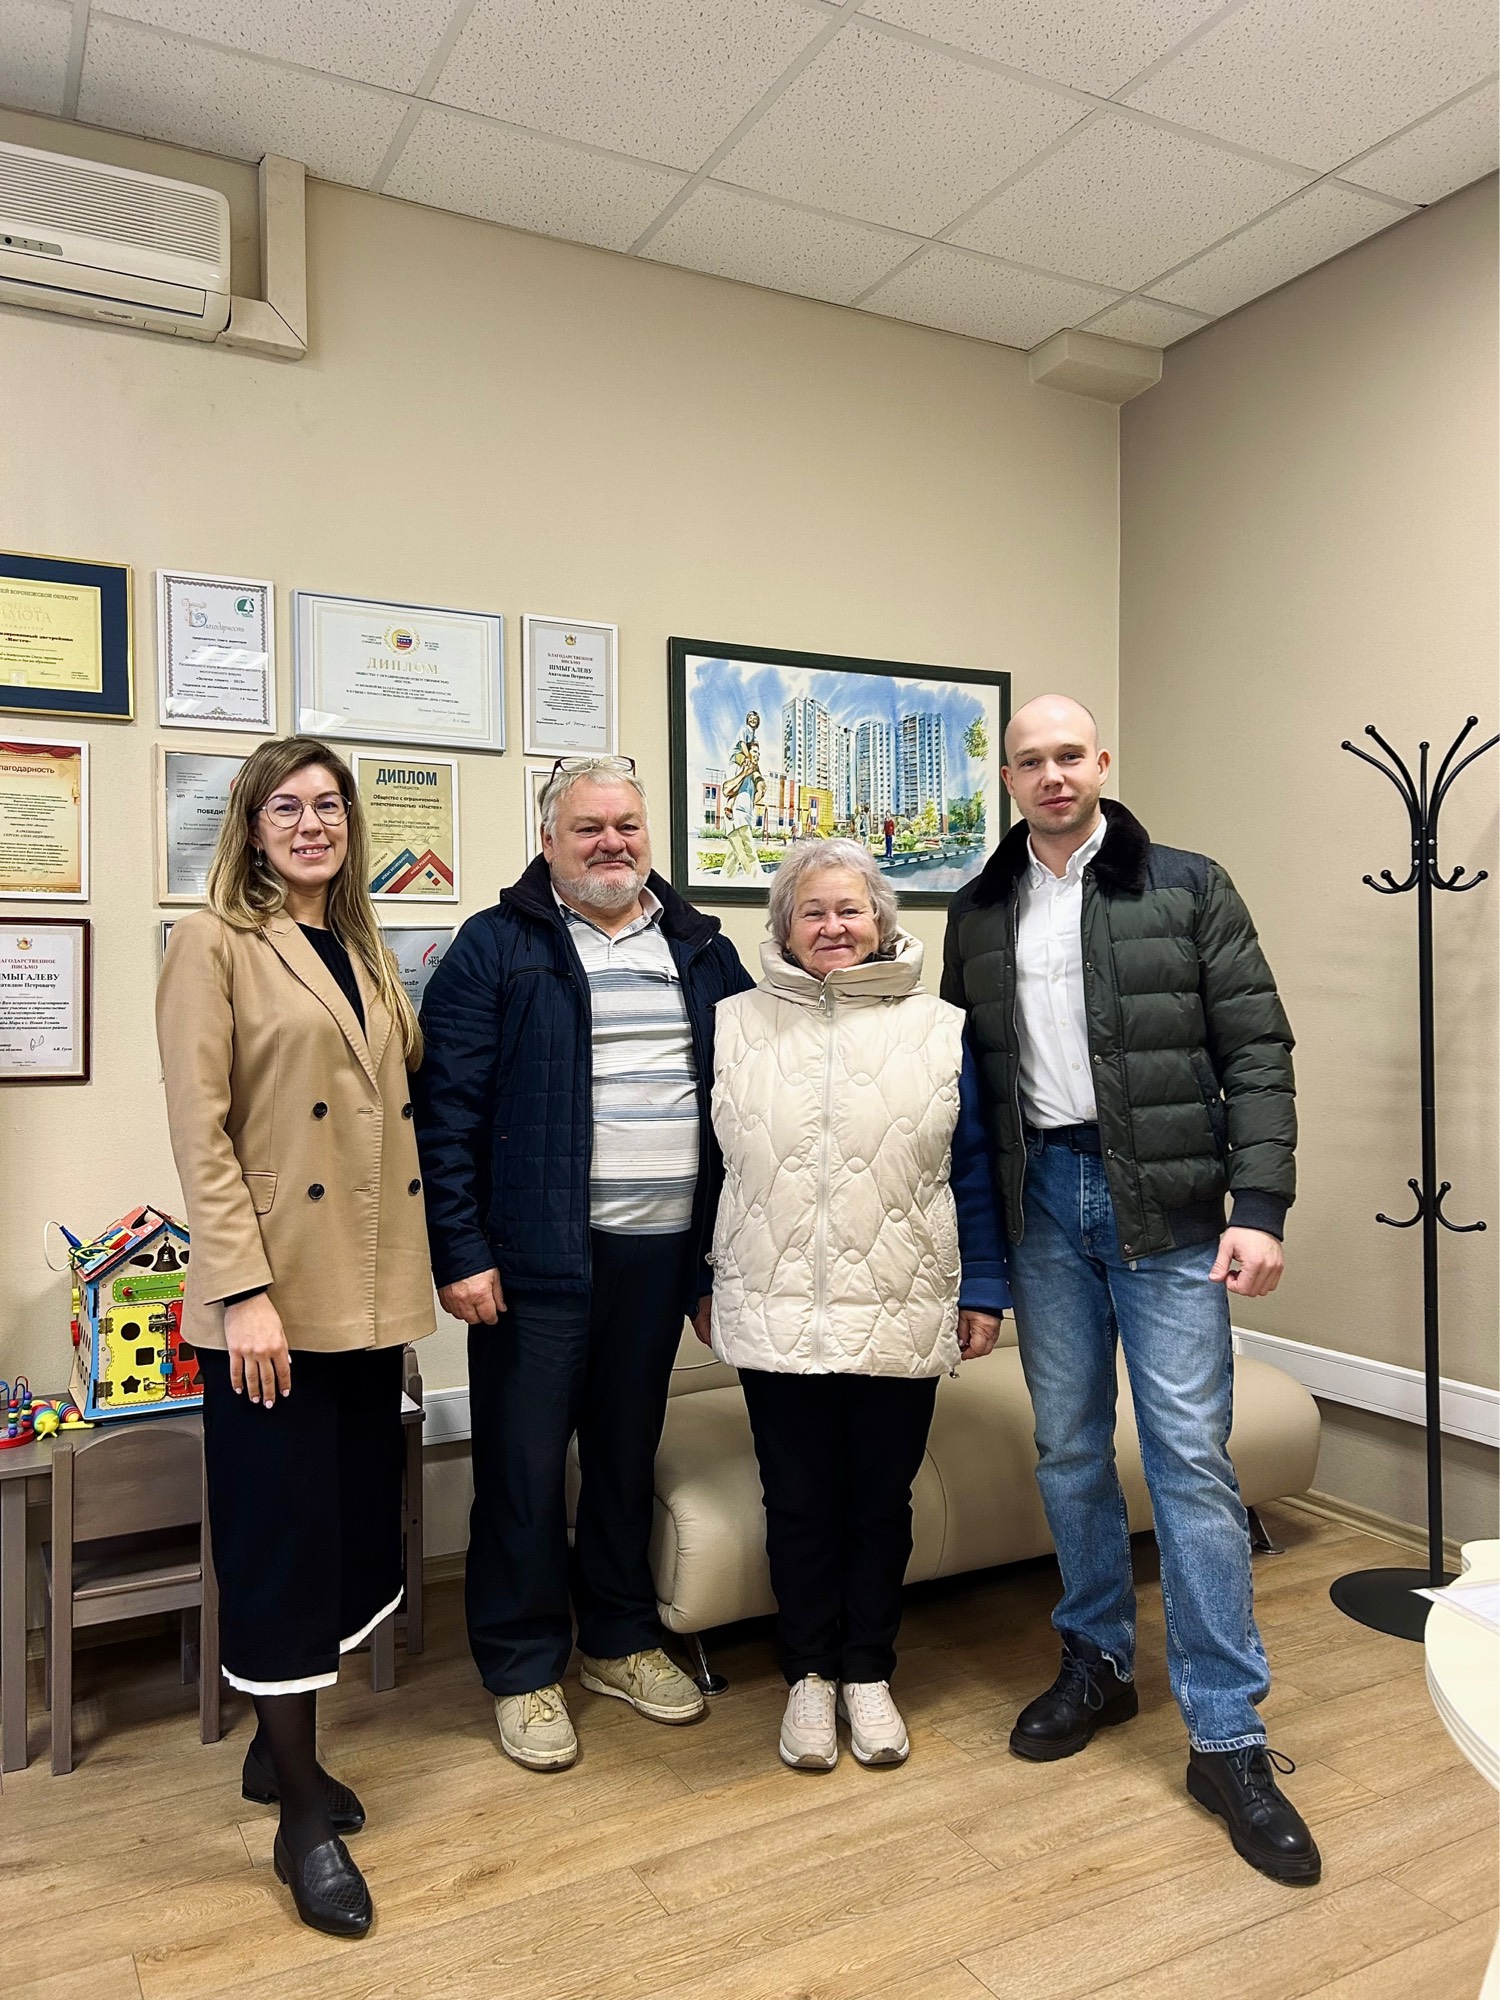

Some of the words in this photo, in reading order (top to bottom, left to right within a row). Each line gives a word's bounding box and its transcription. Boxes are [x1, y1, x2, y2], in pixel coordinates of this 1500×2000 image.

[10, 589, 52, 598] ВОРОНЕЖСКОЙ
[548, 652, 593, 661] БЛАГОДАРСТВЕННОЕ
[367, 657, 439, 675] ДИПЛОМ
[549, 664, 592, 674] ШМЫГАЛЕВУ
[376, 768, 437, 786] ДИПЛОМ
